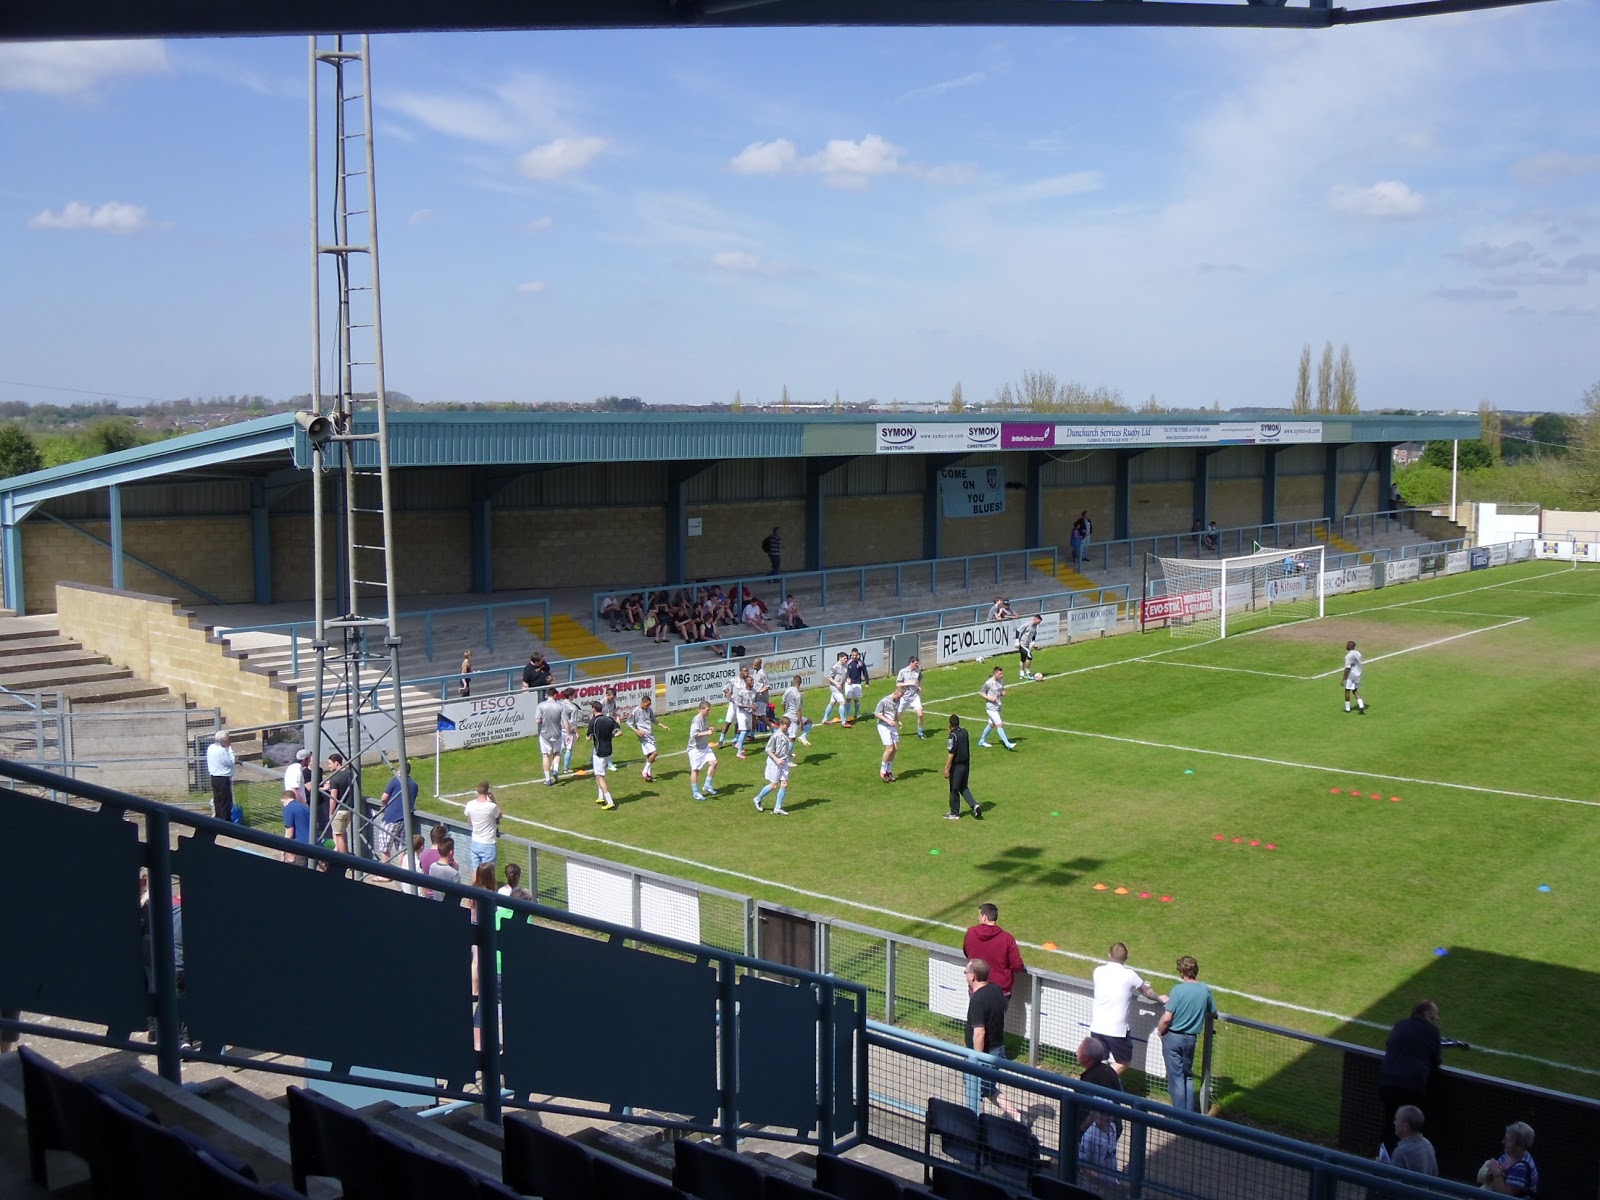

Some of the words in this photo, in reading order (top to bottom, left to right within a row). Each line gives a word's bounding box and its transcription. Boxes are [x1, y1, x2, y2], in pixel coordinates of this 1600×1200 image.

[881, 427, 913, 437] SYMON
[968, 426, 996, 436] SYMON
[1260, 424, 1278, 432] SYMON
[1066, 427, 1098, 437] Dunchurch
[1100, 428, 1121, 437] Services
[1123, 428, 1140, 440] Rugby
[1141, 427, 1151, 436] Ltd
[942, 469, 967, 478] COME
[962, 480, 975, 489] ON
[968, 494, 984, 503] YOU
[973, 501, 1002, 514] BLUES!
[1071, 612, 1088, 622] RUGBY
[1090, 608, 1115, 618] ROOFING
[943, 626, 1009, 658] REVOLUTION
[670, 673, 690, 686] MBG
[693, 669, 736, 682] DECORATORS
[684, 684, 703, 694] (RUGBY)
[470, 696, 515, 711] TESCO
[459, 718, 482, 732] Every
[484, 714, 501, 727] little
[464, 737, 489, 745] LEICESTER
